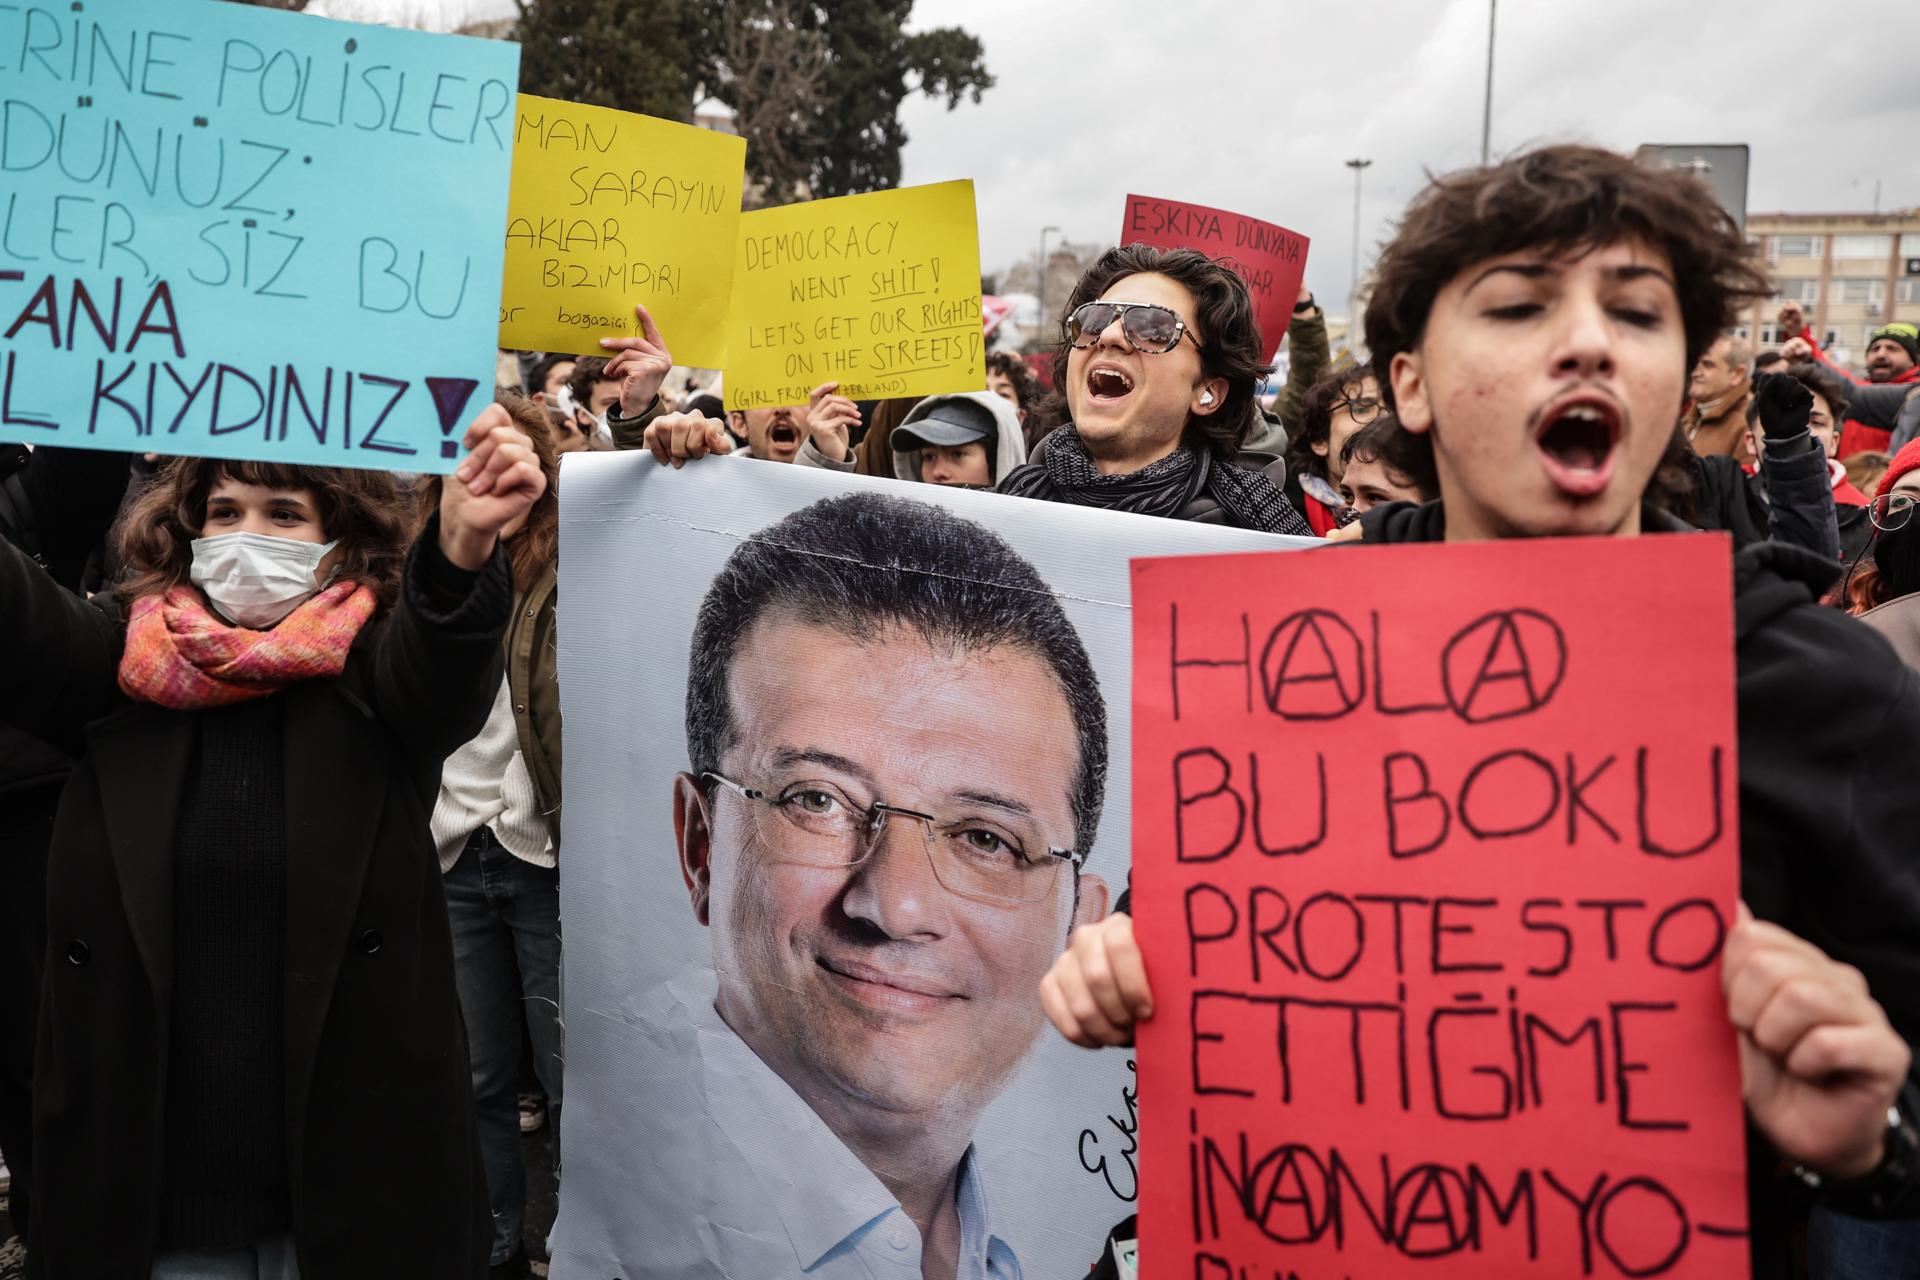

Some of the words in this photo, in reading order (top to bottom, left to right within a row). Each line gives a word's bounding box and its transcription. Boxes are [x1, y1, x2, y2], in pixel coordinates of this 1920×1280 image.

[217, 37, 511, 151] POLİSLER
[517, 113, 618, 153] MAN
[504, 215, 628, 258] AKLAR
[744, 219, 900, 272] DEMOCRACY
[1131, 201, 1224, 242] EŞKIYA
[1235, 218, 1301, 265] DÜNYAYA
[187, 217, 310, 300] SİZ
[358, 236, 471, 320] BU
[789, 274, 853, 303] WENT
[749, 321, 806, 349] LET'S
[814, 315, 860, 342] GET
[869, 307, 915, 336] OUR
[921, 295, 980, 329] RIGHTS
[784, 353, 814, 378] ON
[821, 348, 863, 372] THE
[869, 331, 980, 376] STREETS!
[88, 357, 481, 460] KIYDINIZ!
[776, 385, 813, 401] FROM
[1170, 600, 1568, 725] HALA
[1173, 746, 1328, 864] BU
[1383, 745, 1724, 859] BOKU
[1184, 881, 1727, 983] PROTESTO
[1190, 981, 1692, 1132] ETTİĞİME
